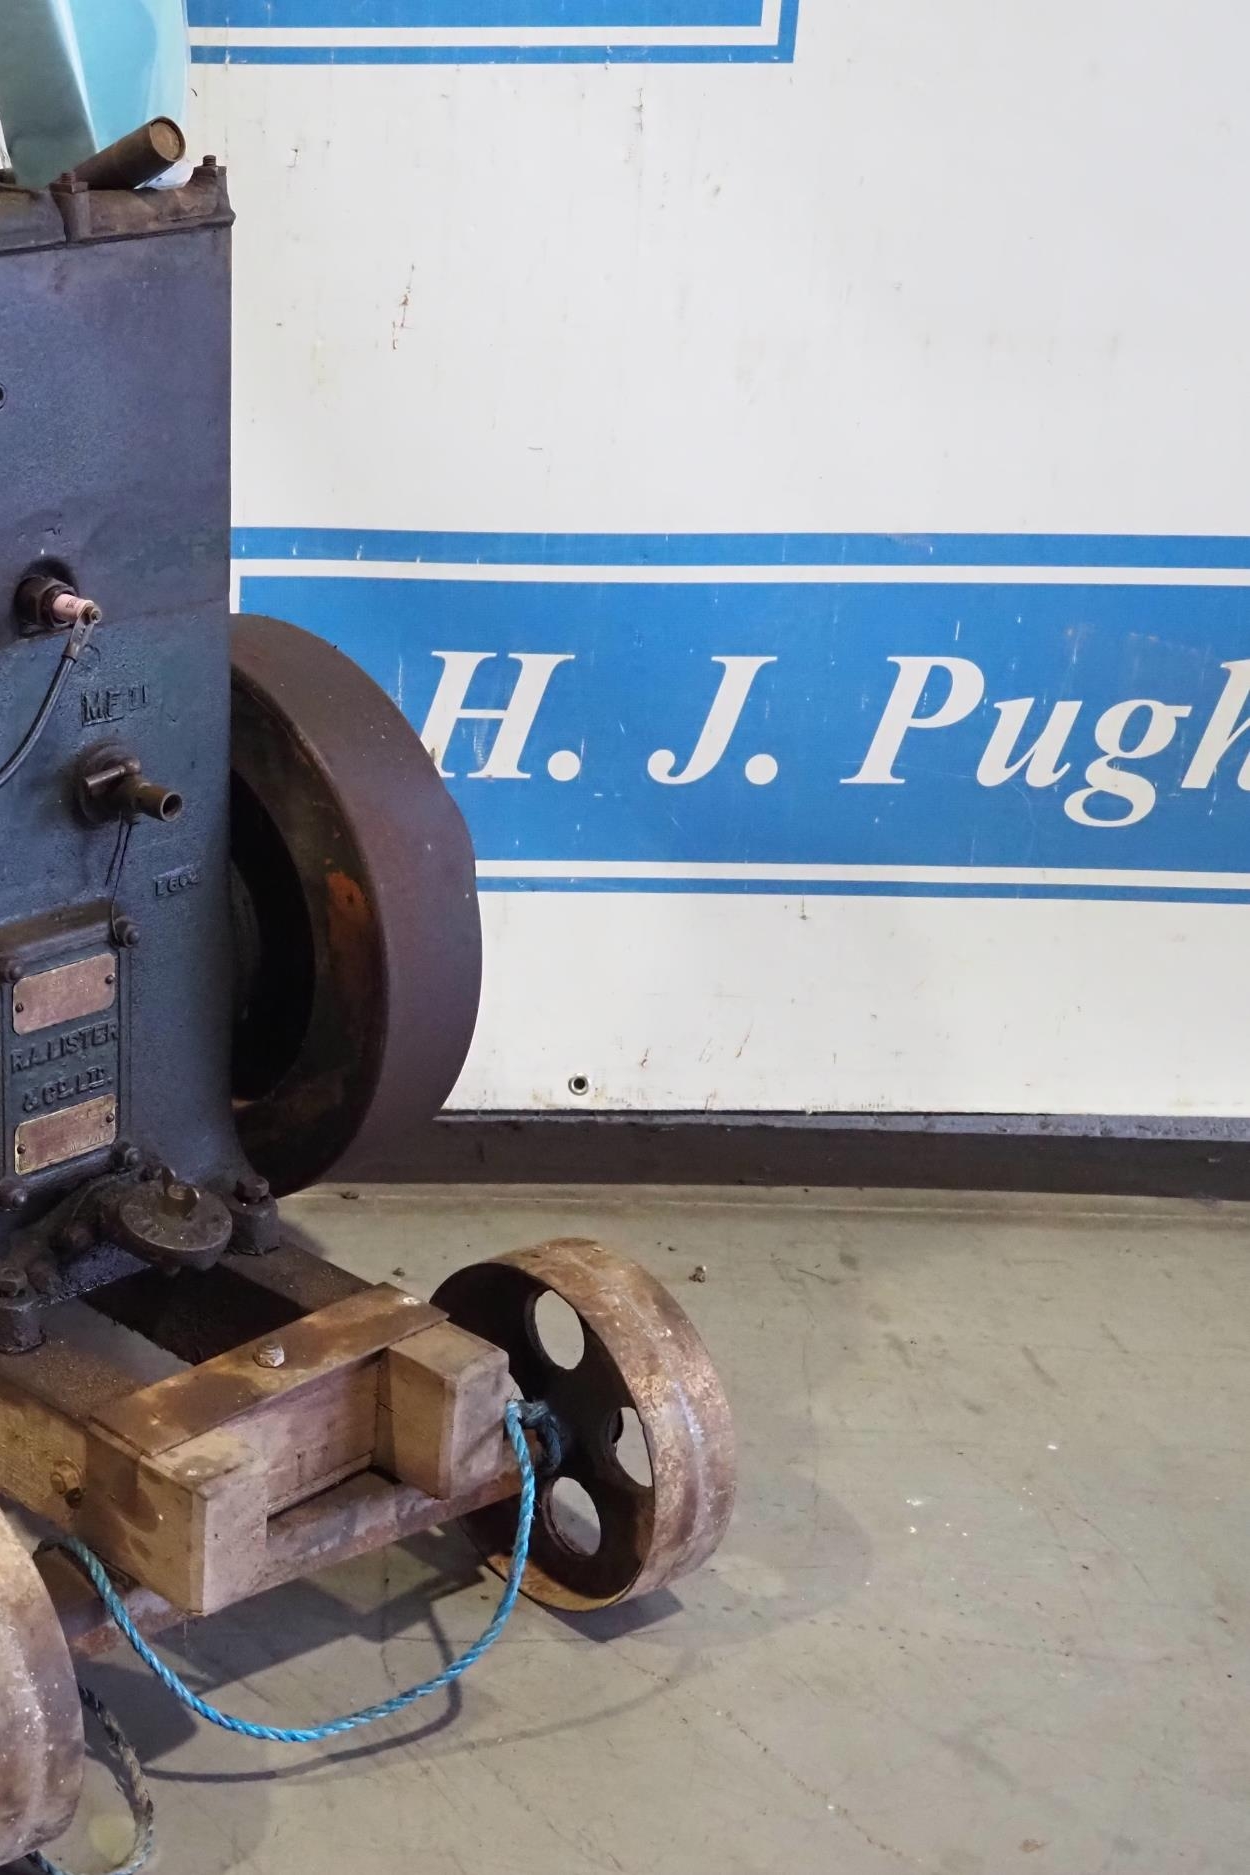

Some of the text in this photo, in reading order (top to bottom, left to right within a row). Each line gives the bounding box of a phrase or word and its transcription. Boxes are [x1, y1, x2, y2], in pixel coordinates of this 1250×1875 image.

[420, 650, 1250, 828] H. J. Pugh
